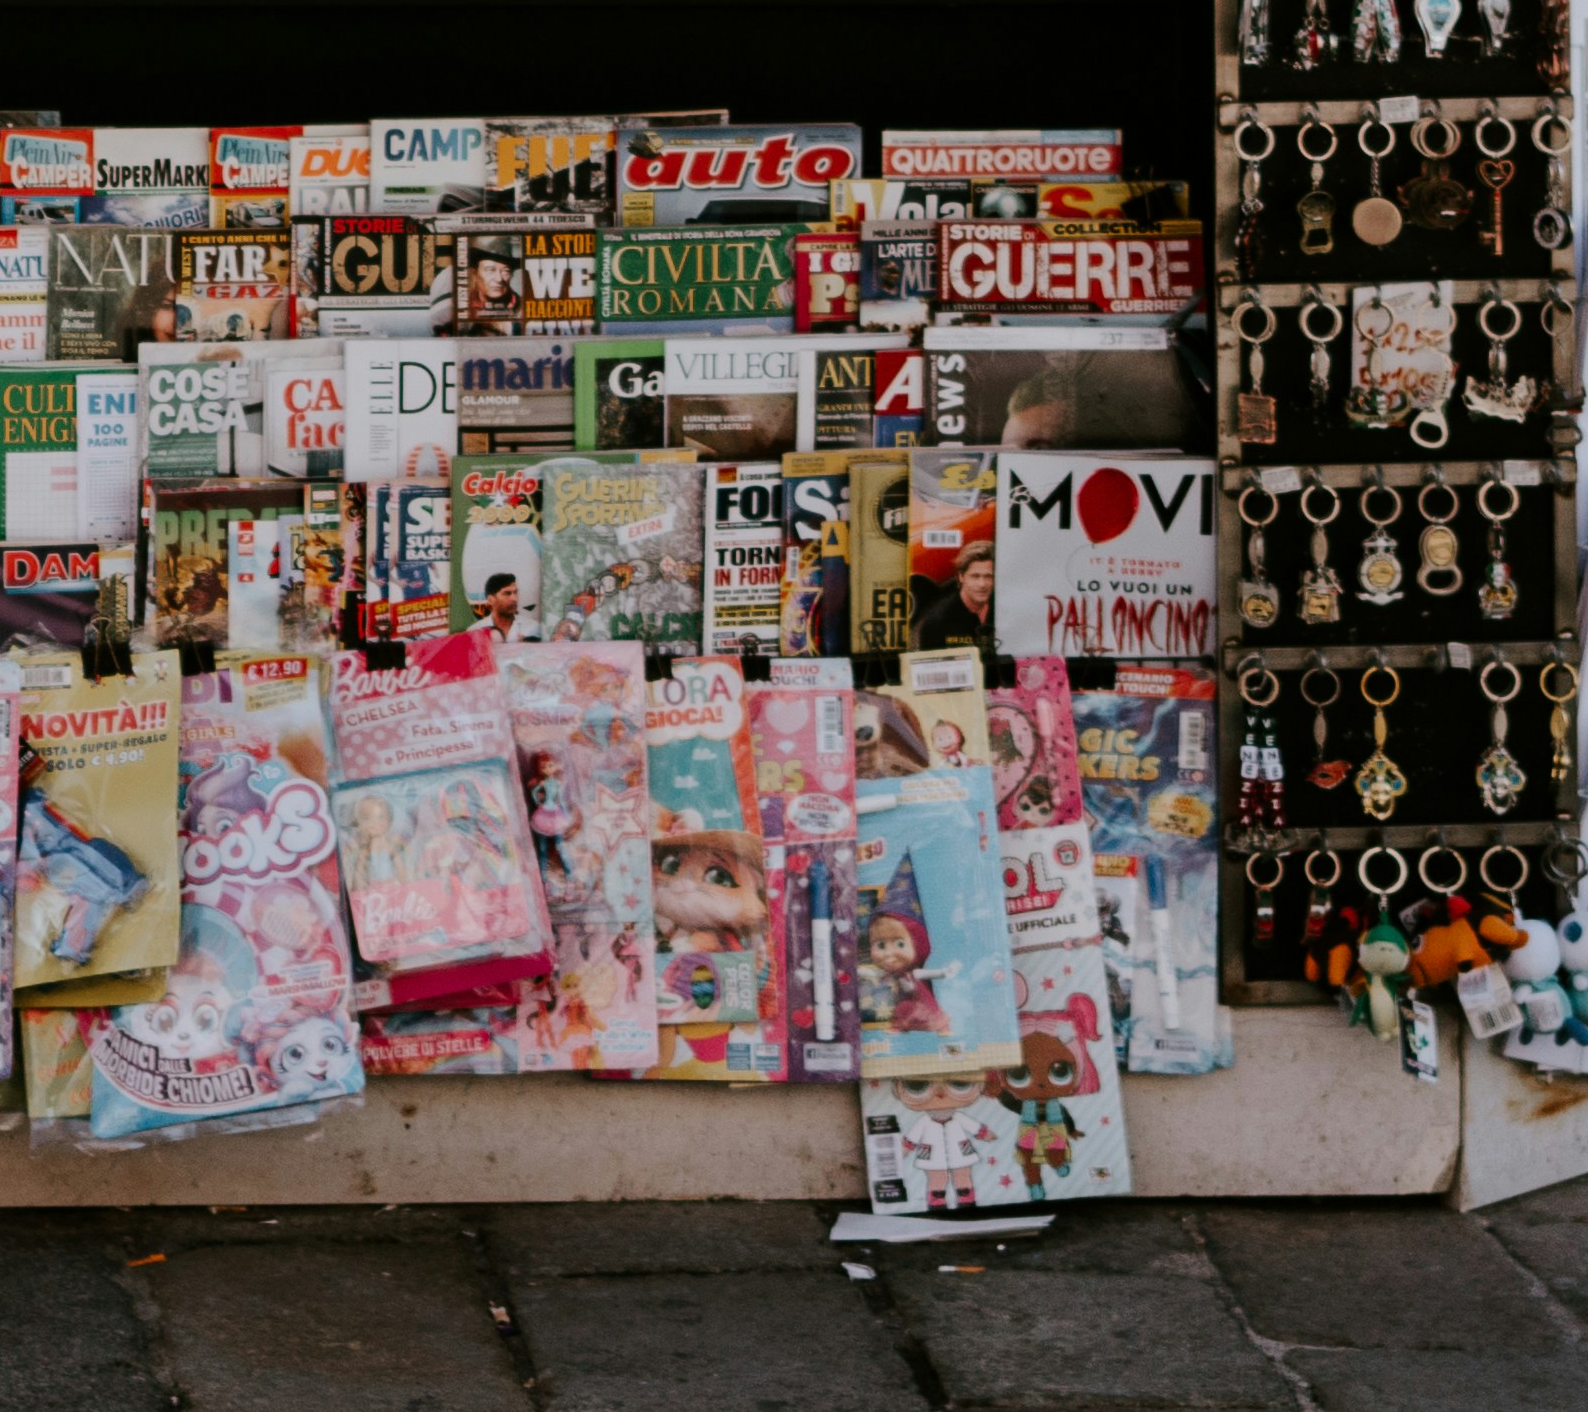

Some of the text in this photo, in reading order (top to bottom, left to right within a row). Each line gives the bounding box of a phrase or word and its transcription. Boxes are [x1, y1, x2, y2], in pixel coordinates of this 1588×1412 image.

[626, 134, 855, 190] auto
[333, 218, 403, 234] STORIE
[950, 224, 1021, 241] STORIE
[194, 245, 266, 284] FAR
[611, 236, 785, 286] CIVILTÀ
[950, 240, 1192, 300] GUERRE
[613, 286, 785, 315] ROMANA
[150, 367, 250, 401] COSE
[150, 401, 249, 436] CASA
[461, 471, 538, 496] Calcio
[1108, 580, 1158, 595] VUOI
[1043, 595, 1211, 657] PALLONCINO
[330, 658, 434, 703] Barbie
[345, 698, 420, 730] CHELSEA
[1016, 915, 1077, 933] UFFICIALE
[364, 1035, 484, 1060] POLVERE STELLE
